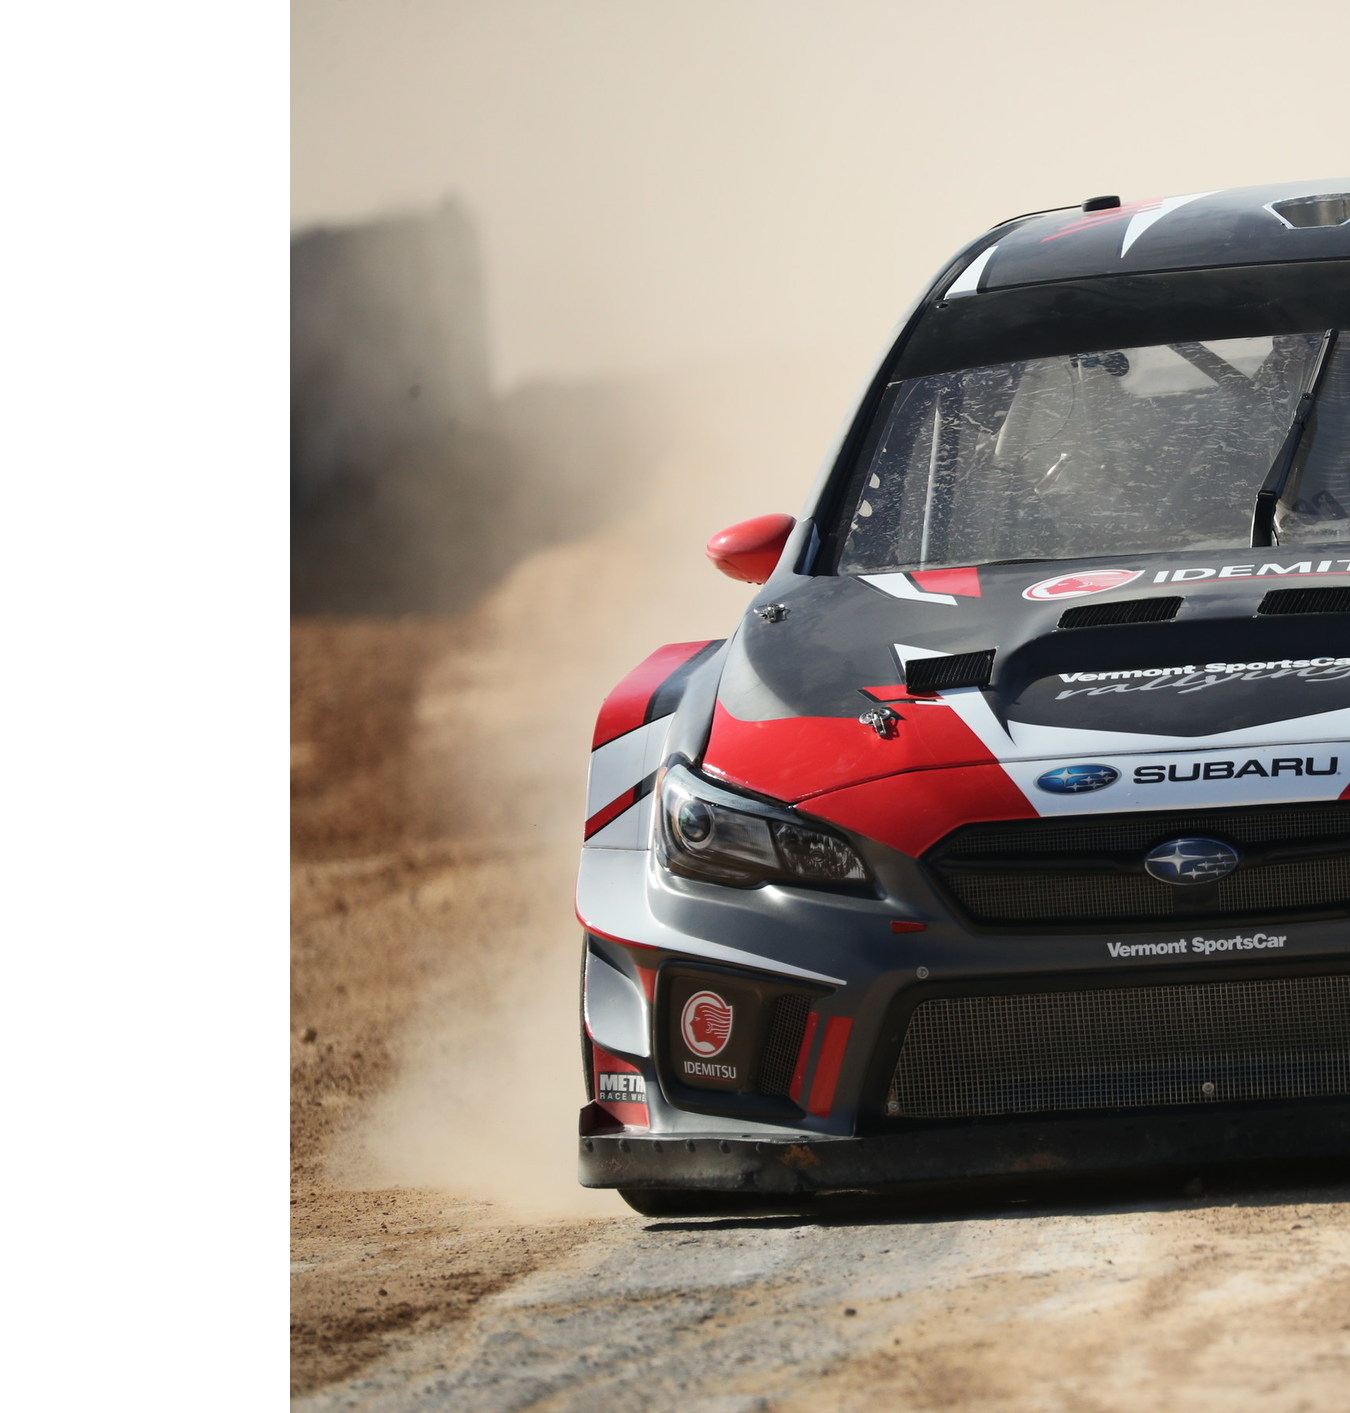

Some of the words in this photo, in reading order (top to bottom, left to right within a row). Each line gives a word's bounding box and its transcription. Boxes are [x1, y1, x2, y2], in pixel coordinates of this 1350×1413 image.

[1058, 664, 1196, 683] Vermont
[1132, 756, 1340, 784] SUBARU
[1107, 939, 1188, 957] Vermont
[1192, 933, 1287, 955] SportsCar
[684, 1061, 737, 1079] IDEMITSU
[600, 1092, 627, 1100] RACE
